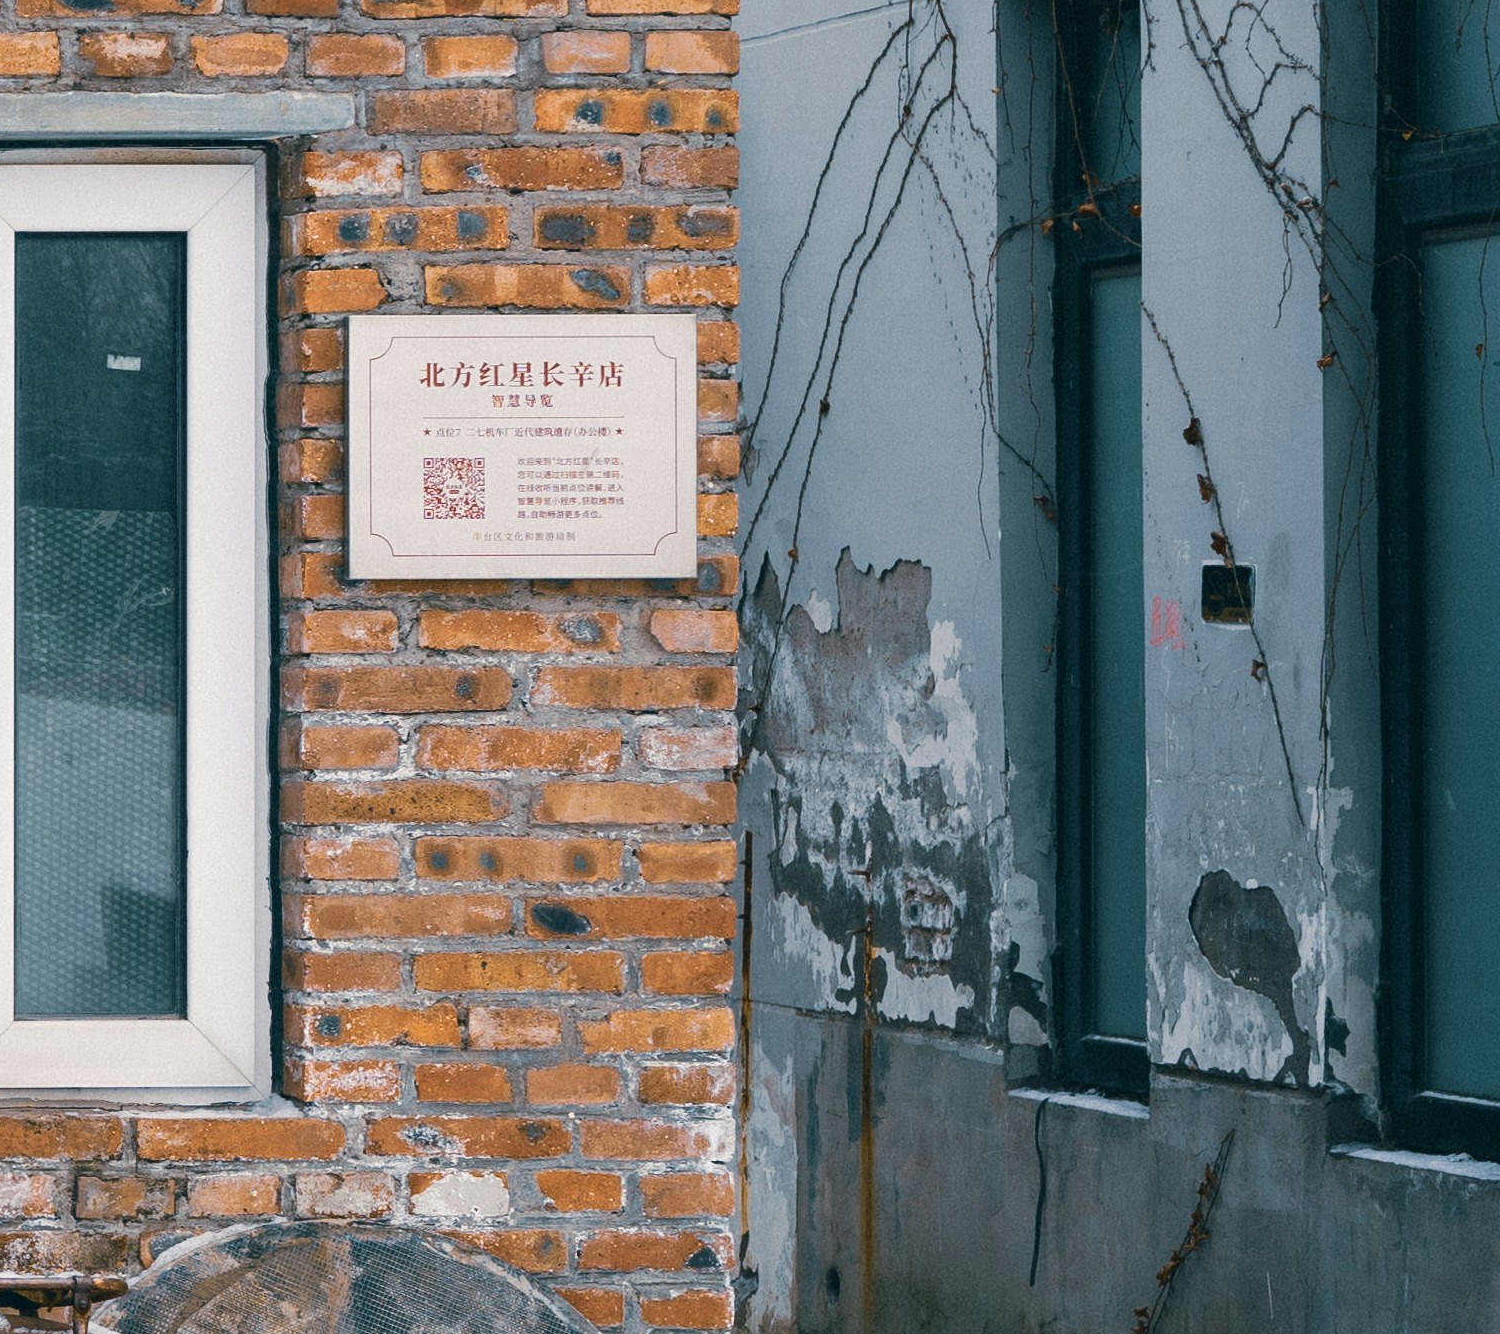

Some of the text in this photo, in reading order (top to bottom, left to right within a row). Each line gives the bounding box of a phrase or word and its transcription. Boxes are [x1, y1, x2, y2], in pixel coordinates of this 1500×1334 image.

[419, 360, 625, 389] 北方红星长辛店
[491, 393, 555, 409] 智慧导览
